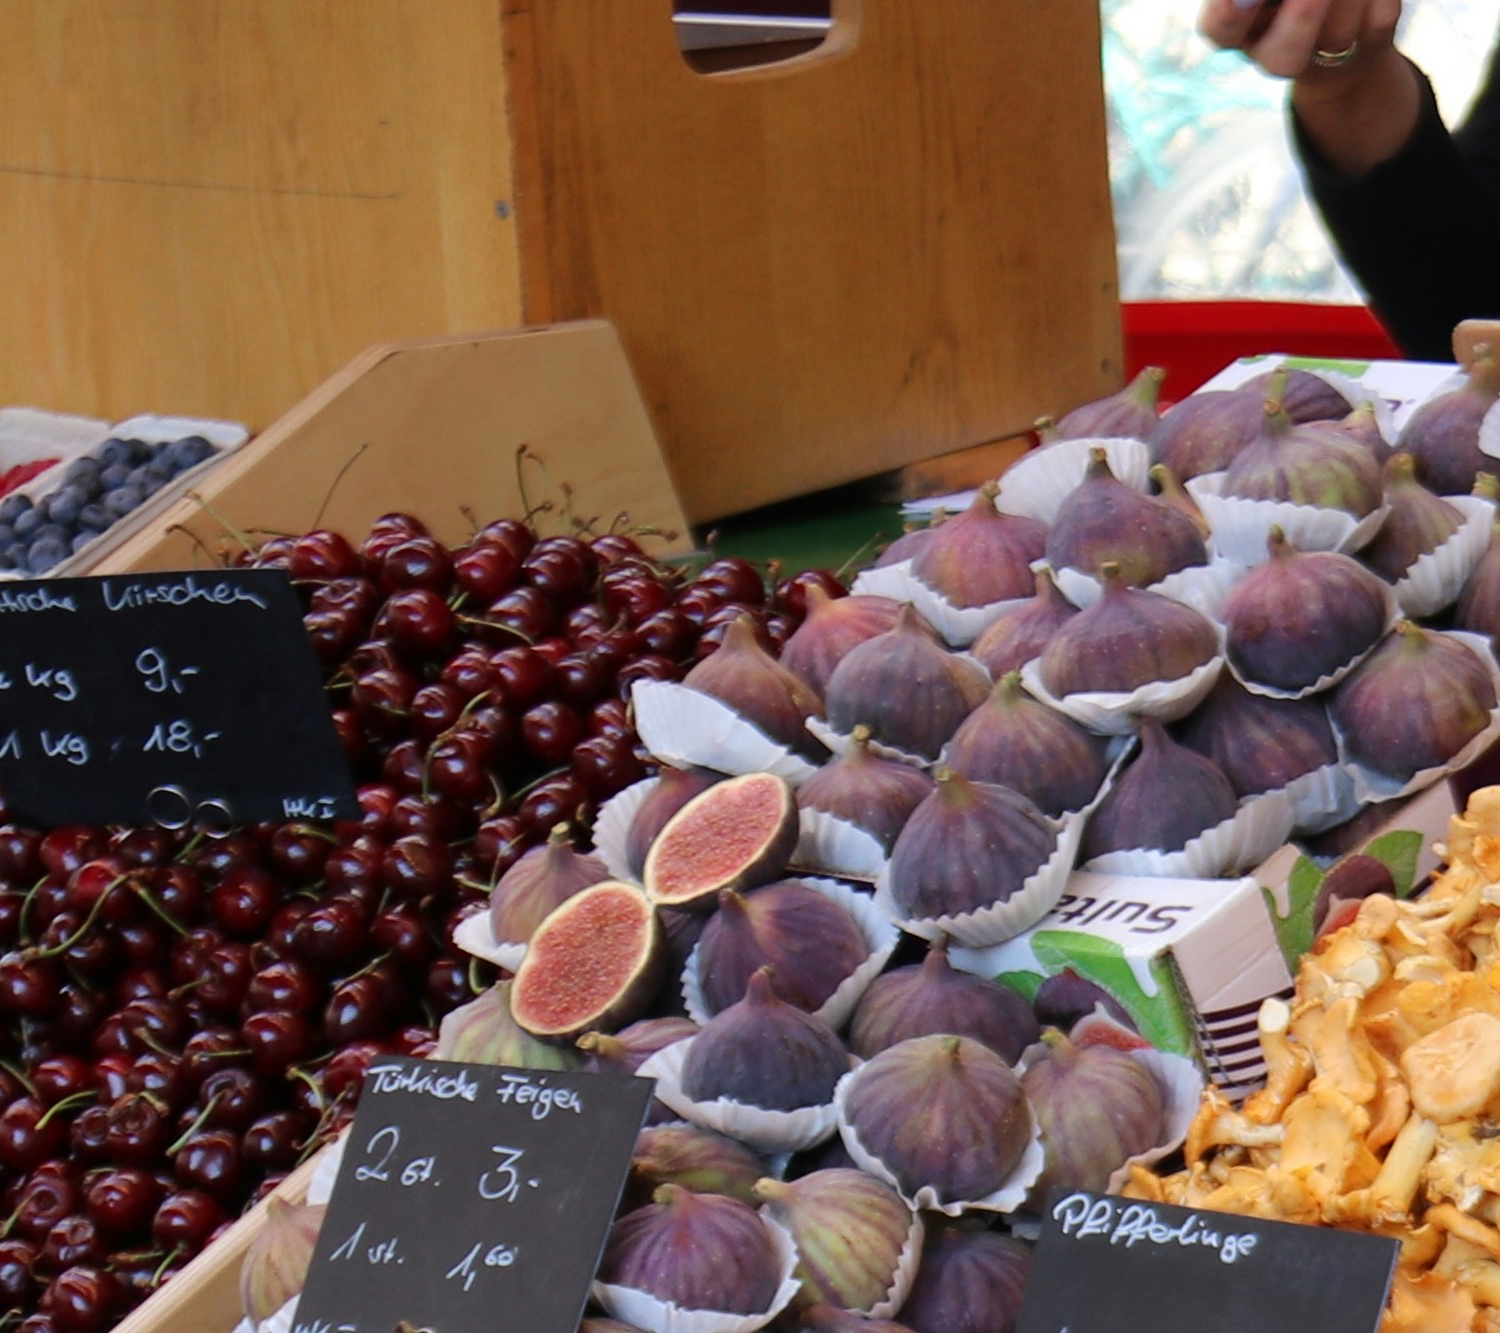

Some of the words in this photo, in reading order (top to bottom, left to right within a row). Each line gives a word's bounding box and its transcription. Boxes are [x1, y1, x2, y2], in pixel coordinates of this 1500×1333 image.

[101, 574, 268, 612] Kirschen
[25, 662, 78, 702] kg
[40, 730, 90, 766] kg
[496, 1073, 582, 1121] Feigen
[354, 1125, 399, 1183] 2
[329, 1222, 366, 1262] 1
